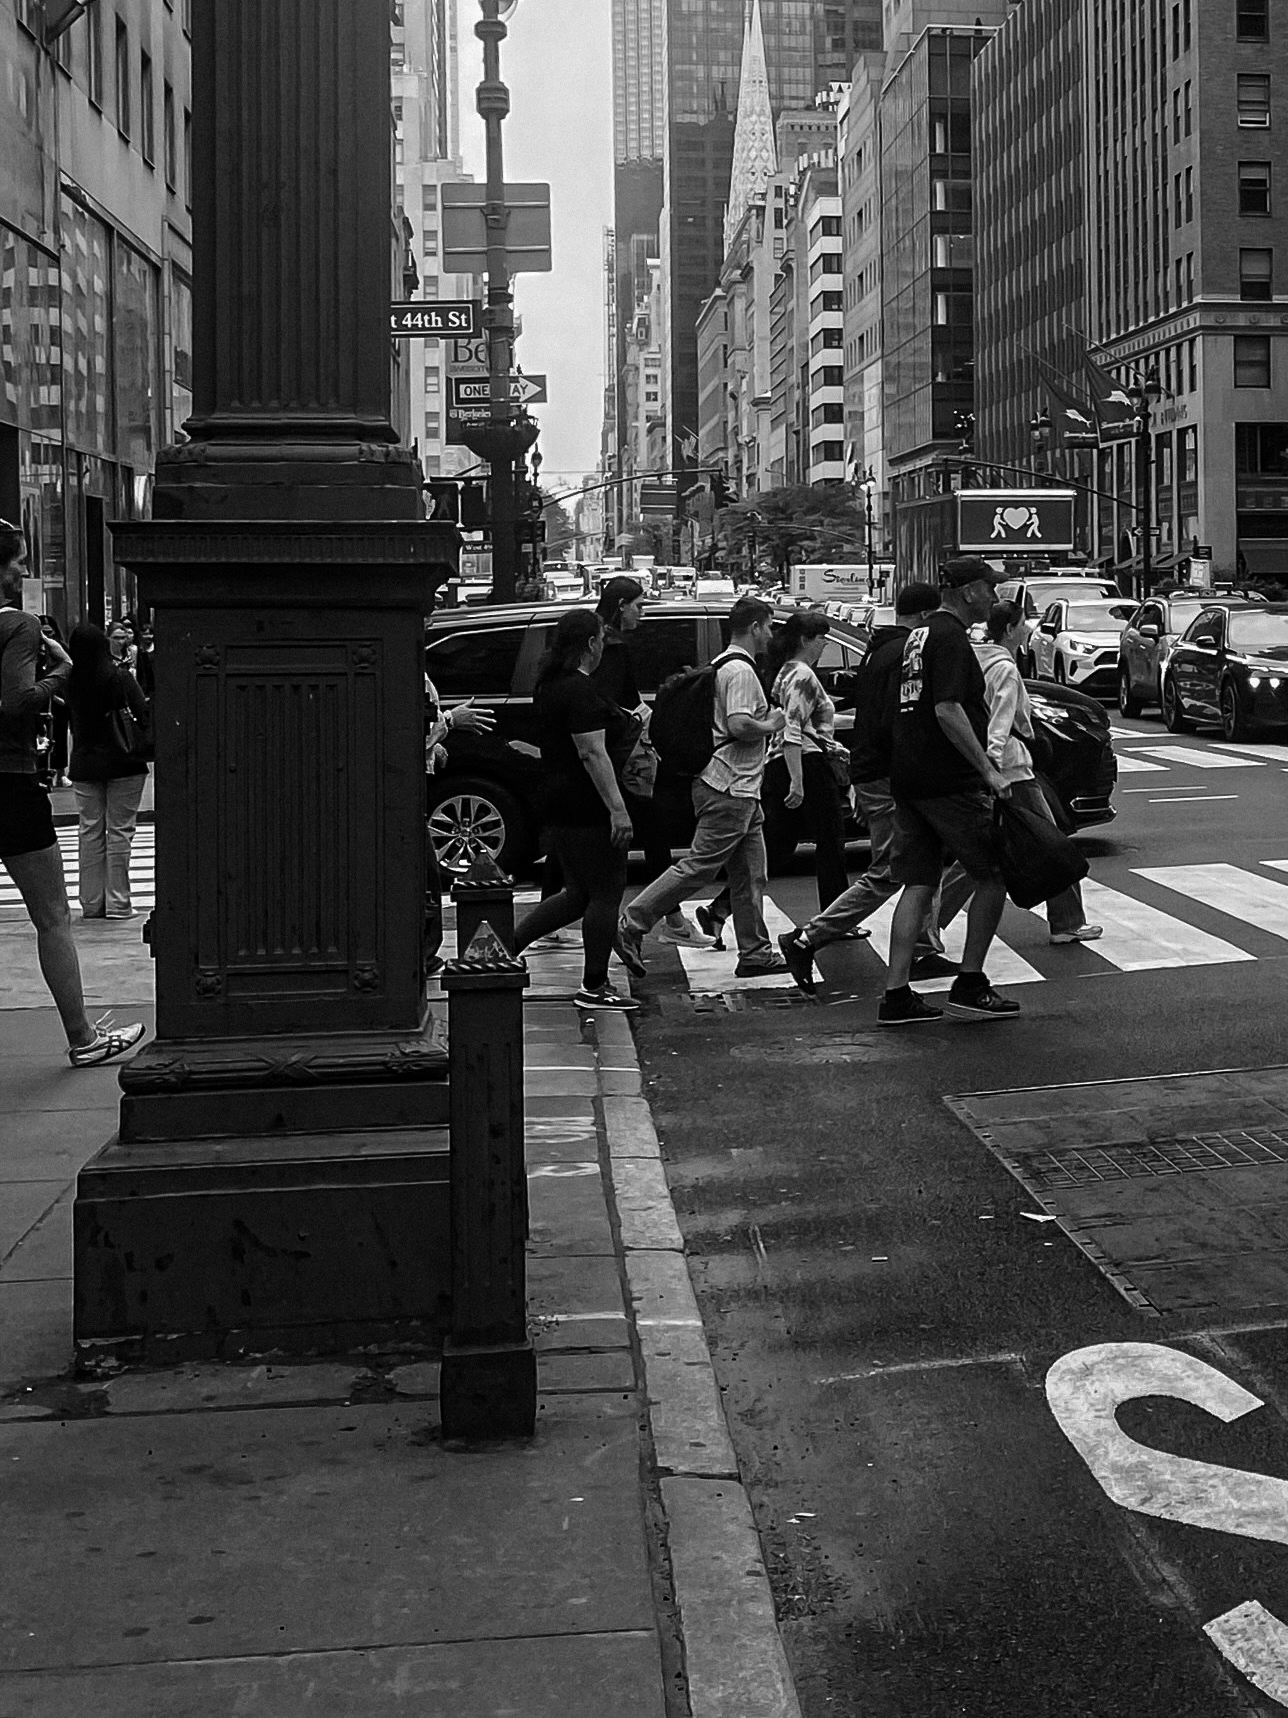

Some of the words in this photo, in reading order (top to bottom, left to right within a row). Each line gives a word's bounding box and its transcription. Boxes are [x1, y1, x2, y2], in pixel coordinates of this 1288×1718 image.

[402, 312, 443, 328] 44th
[448, 311, 468, 327] St
[464, 385, 490, 397] ONE
